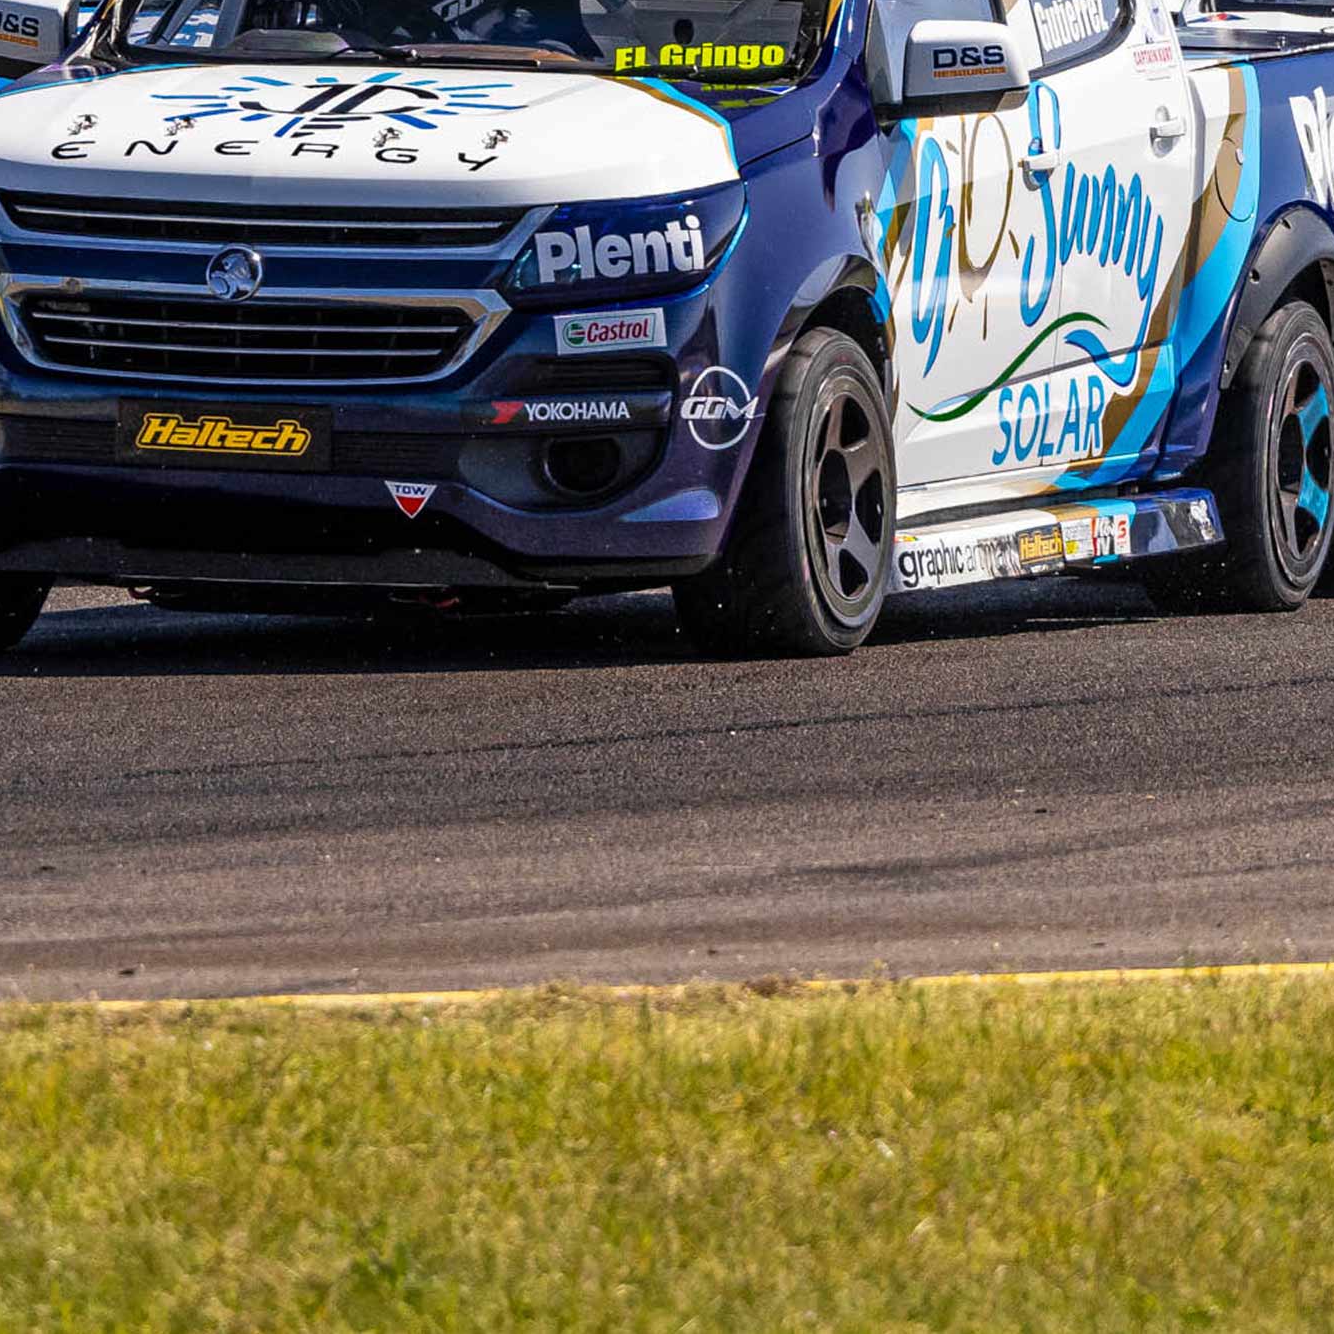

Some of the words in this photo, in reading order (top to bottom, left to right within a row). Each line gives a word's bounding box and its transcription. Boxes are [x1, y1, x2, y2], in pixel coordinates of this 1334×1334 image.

[659, 42, 786, 71] Gringo
[932, 45, 1005, 69] D&S
[51, 139, 501, 172] ENERGY
[534, 214, 705, 284] Plenti
[587, 318, 649, 344] Castrol
[525, 401, 631, 422] YOKOHAMA
[991, 374, 1106, 466] SOLAR
[135, 413, 312, 457] Haltech
[394, 484, 428, 496] TOW
[1019, 528, 1063, 565] Haltech
